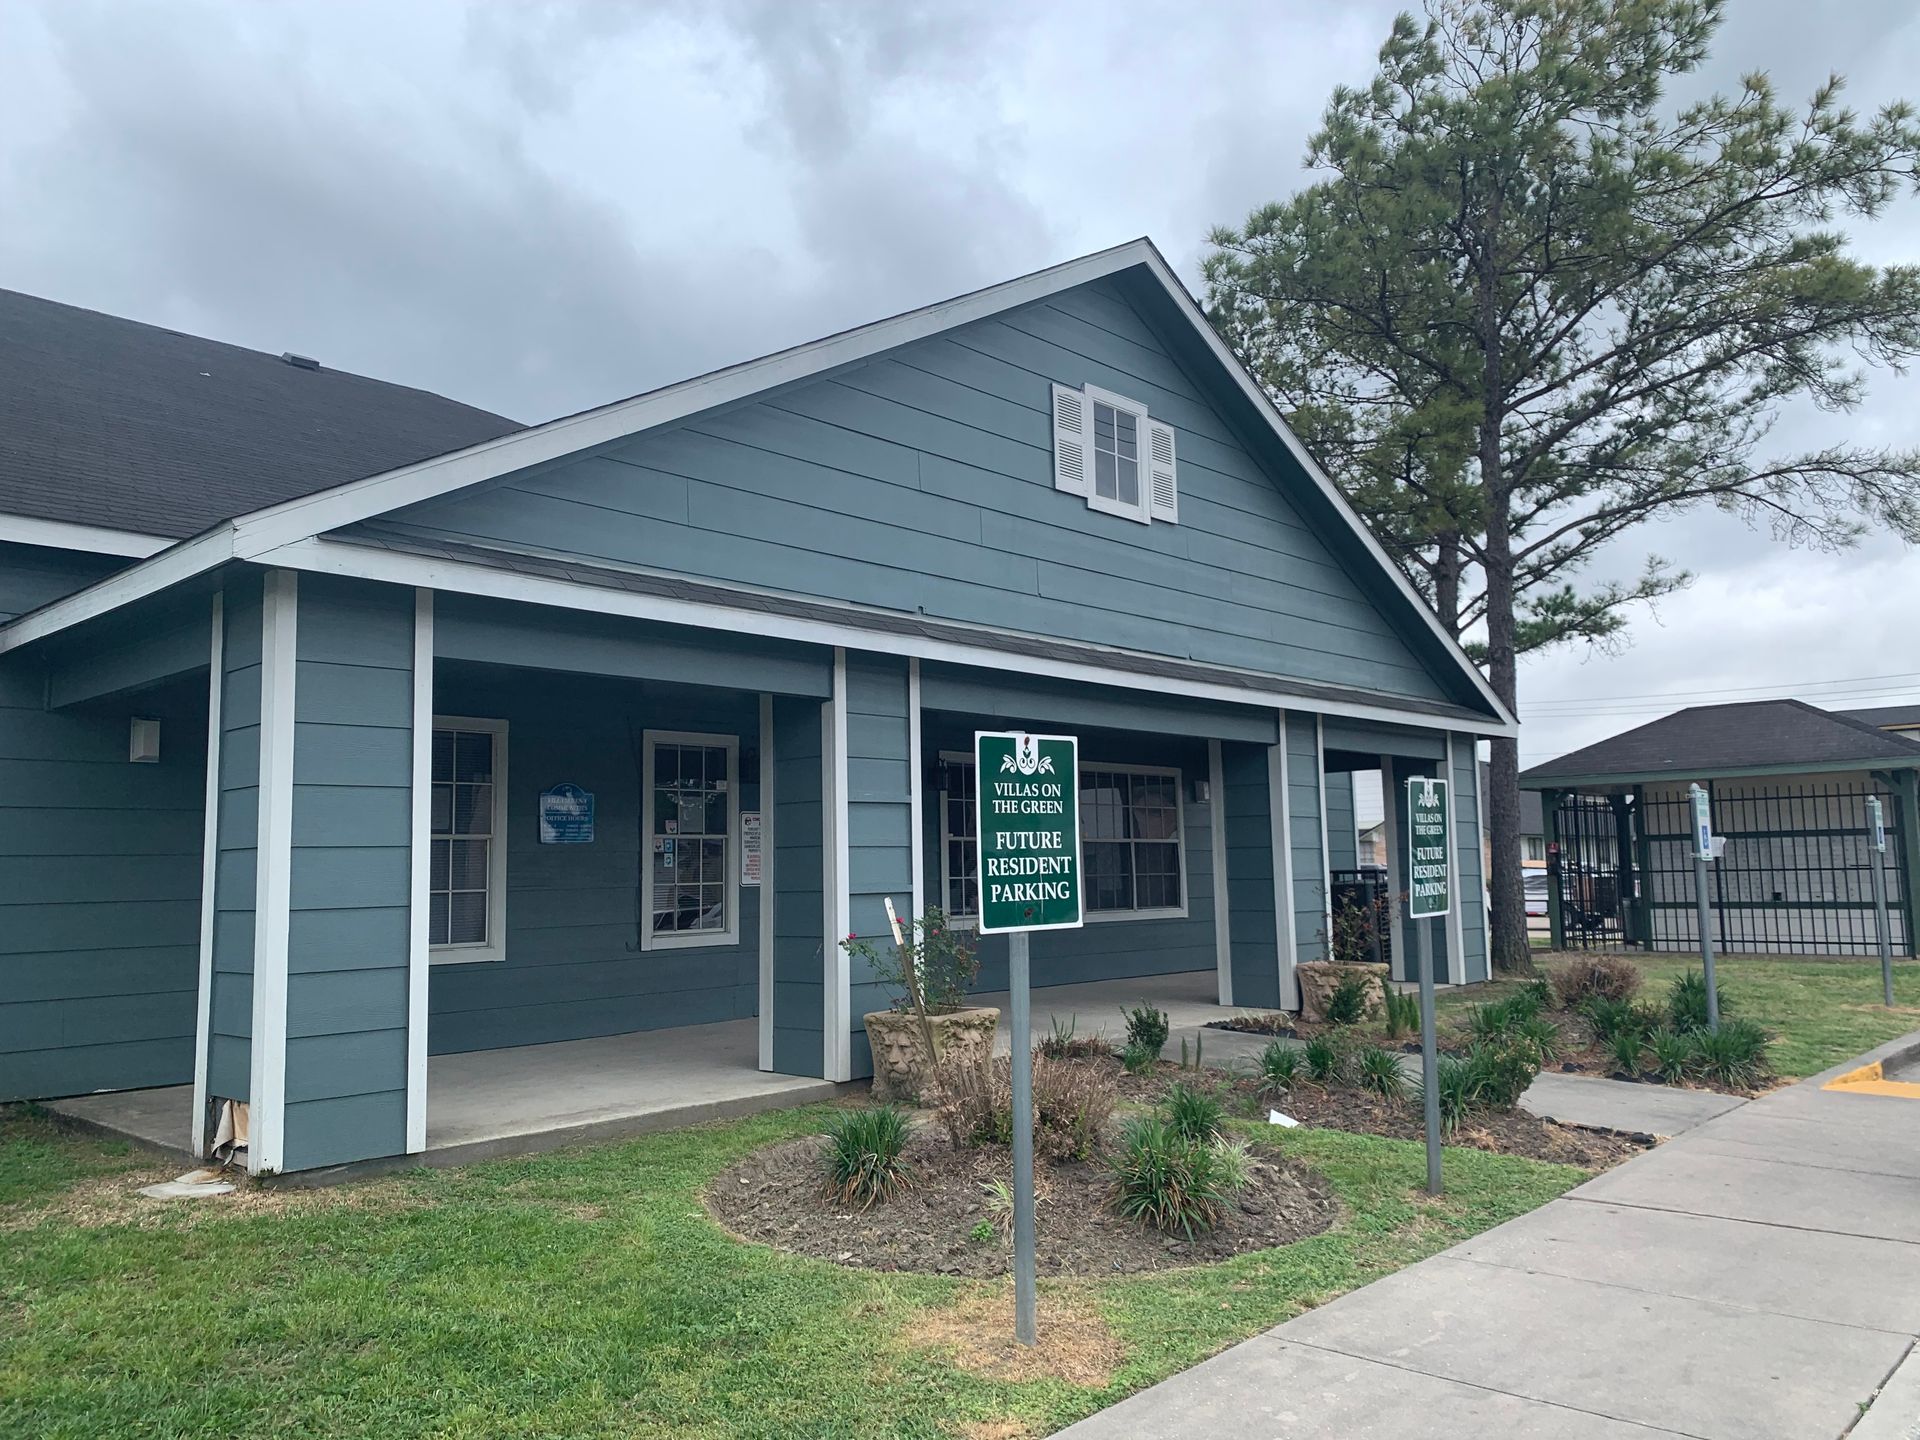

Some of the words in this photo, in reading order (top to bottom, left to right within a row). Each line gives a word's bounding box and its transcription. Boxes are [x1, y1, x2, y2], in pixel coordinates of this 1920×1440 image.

[994, 783, 1039, 797] VILLAS
[1042, 784, 1061, 797] ON
[993, 800, 1018, 813] THE
[1021, 800, 1063, 814] GREEN
[1415, 813, 1433, 823] VILLAS
[1434, 813, 1443, 823] ON
[1415, 825, 1426, 835] THE
[1426, 825, 1443, 835] GREEN
[995, 831, 1062, 850] FUTURE
[1417, 847, 1443, 860] FUTURE
[987, 856, 1072, 876] RESIDENT
[1413, 864, 1447, 879] RESIDENT
[990, 881, 1070, 903] PARKING
[1415, 882, 1447, 897] PARKING
